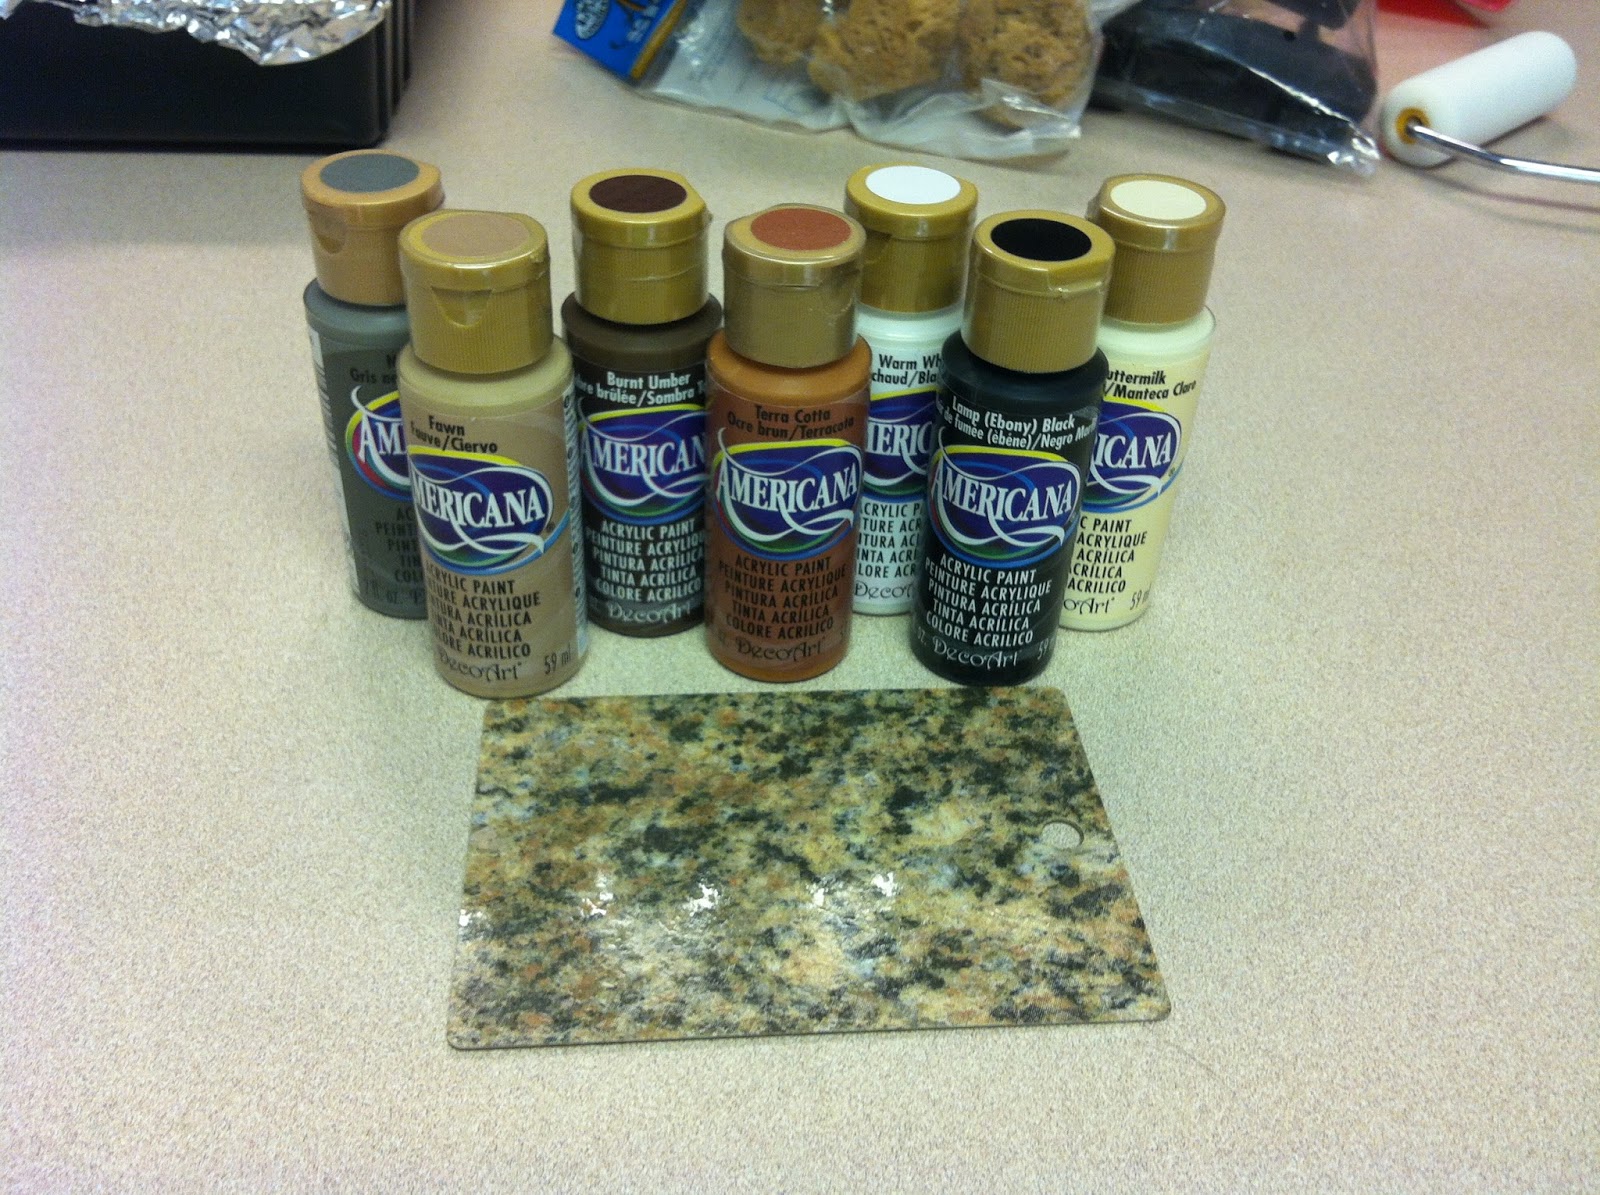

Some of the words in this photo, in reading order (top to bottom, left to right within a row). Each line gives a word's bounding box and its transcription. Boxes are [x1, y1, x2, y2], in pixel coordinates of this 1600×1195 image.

[879, 353, 918, 371] Warm
[607, 371, 644, 390] Burnt
[648, 372, 691, 390] Umber
[727, 411, 754, 433] Ocre
[755, 404, 789, 423] Terra
[794, 409, 831, 424] Cotta
[952, 395, 981, 427] Lamp
[984, 411, 1038, 437] (Ebony)
[1042, 414, 1076, 434] Black
[428, 415, 465, 437] Fawn
[716, 455, 858, 514] AMERICANA
[931, 457, 1072, 522] AMERICANA
[601, 520, 655, 540] ACRYLIC
[660, 519, 696, 540] PAINT
[1092, 518, 1133, 534] PAINT
[1076, 531, 1148, 549] ACRYLIQUE
[593, 546, 646, 572] PINTURA
[735, 554, 789, 577] ACRYLIC
[795, 556, 831, 576] PAINT
[940, 553, 992, 583] ACRYLIC
[996, 569, 1037, 586] PAINT
[472, 579, 516, 596] PAINT
[601, 565, 636, 587] TINTA
[719, 560, 774, 592] PEINTURE
[781, 563, 847, 593] ACRYLIQUE
[925, 557, 977, 597] PEINTURE
[981, 579, 1053, 601] ACRYLIQUE
[1067, 577, 1126, 594] ACRILICO
[596, 578, 642, 601] COLORE
[647, 578, 701, 602] ACRILICO
[725, 580, 777, 608] PINTURA
[854, 580, 914, 599] Deco
[928, 578, 976, 613] PINTURA
[463, 591, 541, 612] ACRYLIQUE
[732, 600, 766, 623] TINTA
[933, 598, 964, 625] TINTA
[726, 614, 773, 639] COLORE
[778, 616, 834, 640] ACRILICO
[926, 611, 969, 643] COLORE
[973, 629, 1034, 648] ACRILICO
[467, 643, 532, 660] ACRILICO
